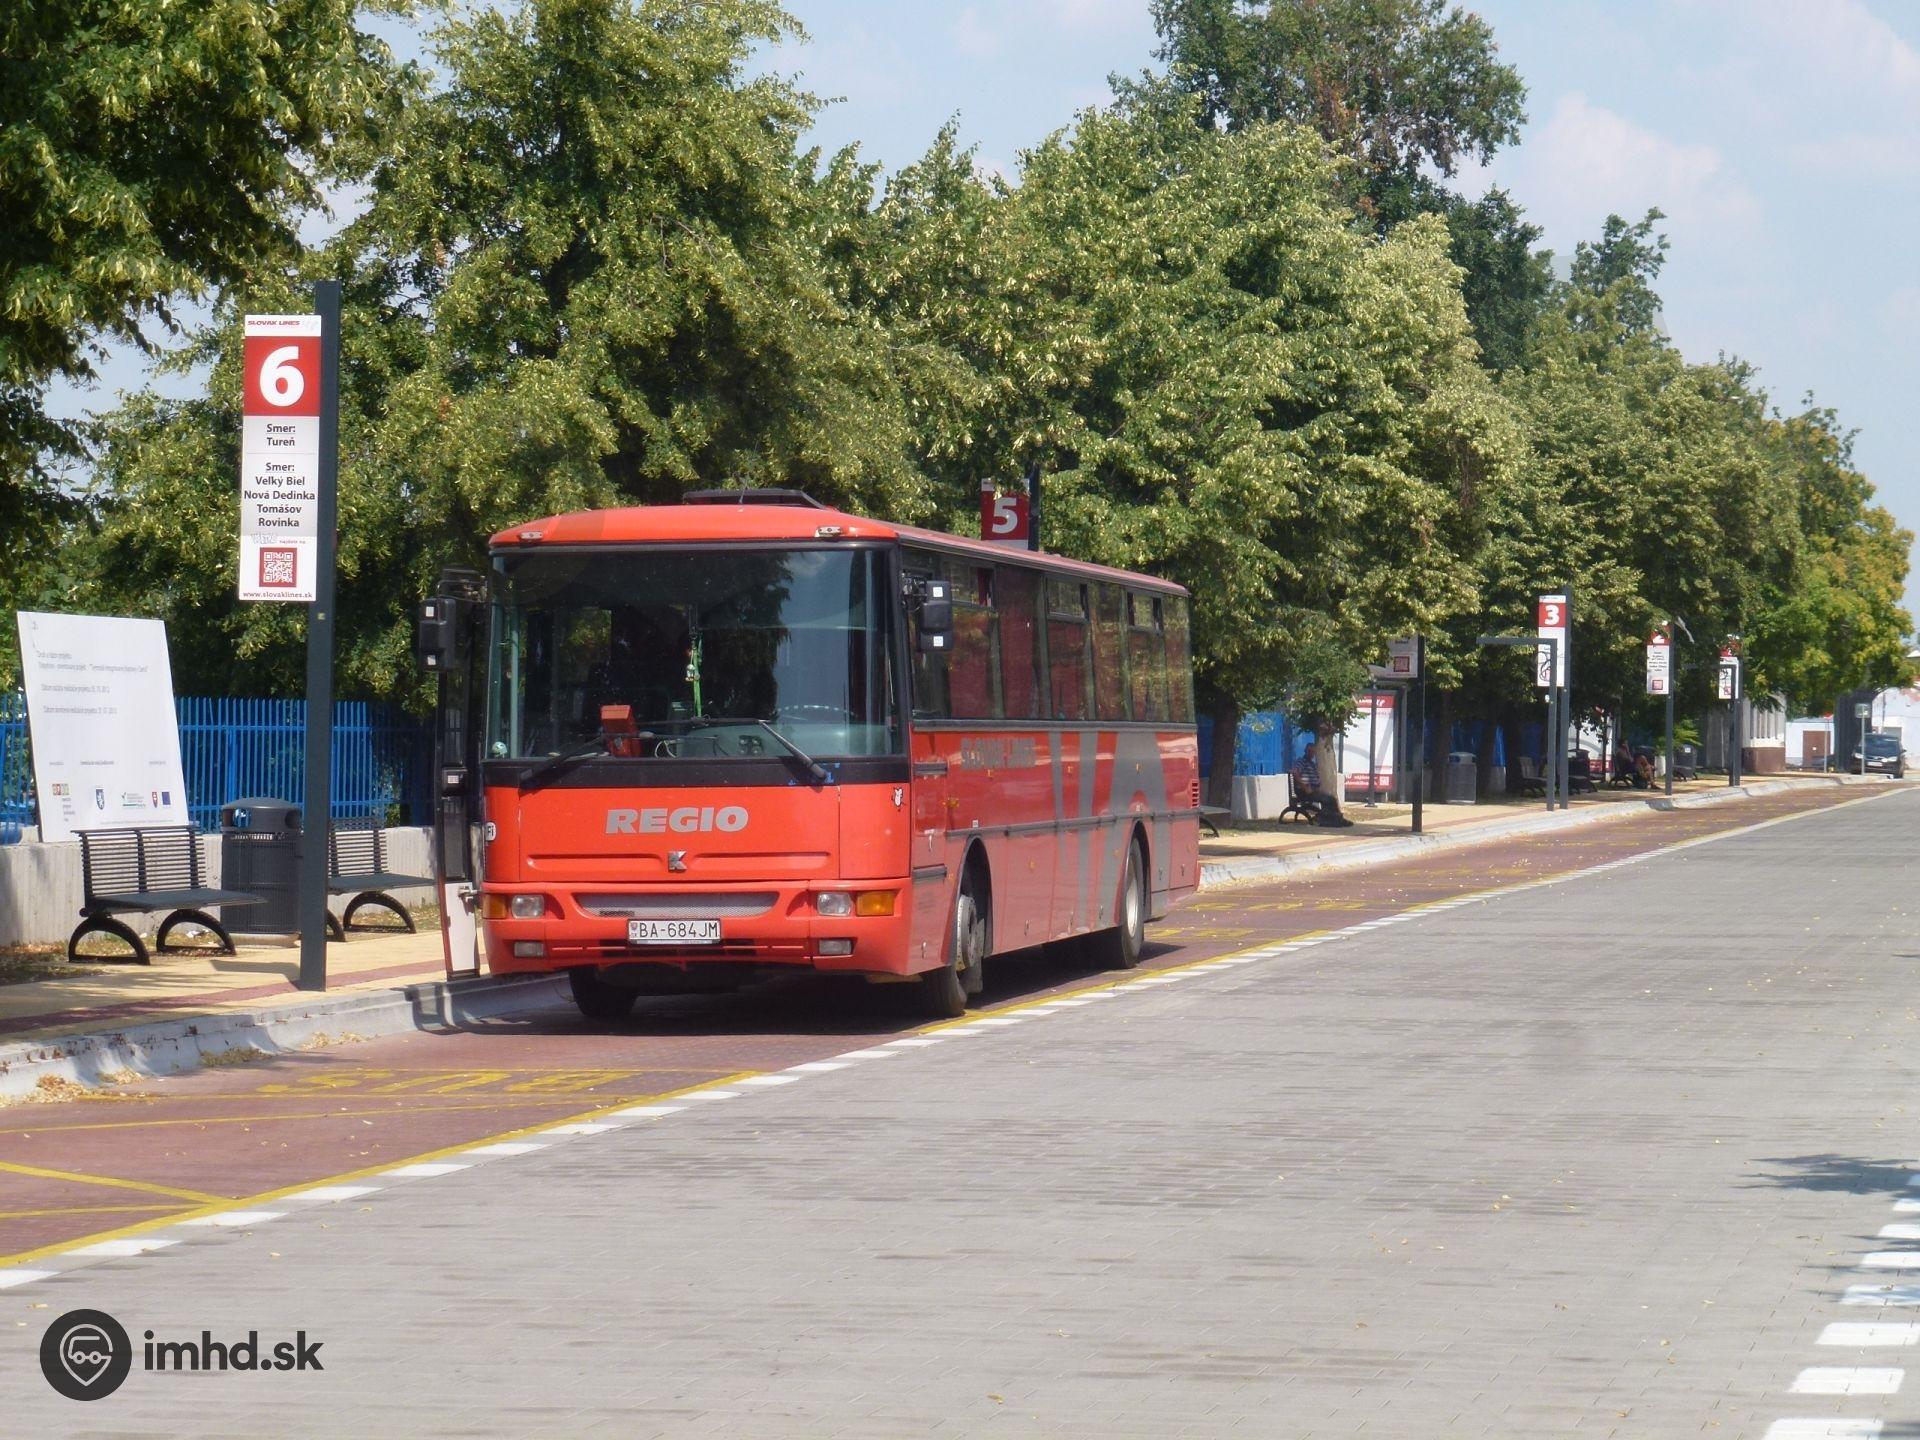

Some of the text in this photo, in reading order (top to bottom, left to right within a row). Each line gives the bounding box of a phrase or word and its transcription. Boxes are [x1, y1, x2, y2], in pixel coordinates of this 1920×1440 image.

[260, 345, 304, 407] 6
[266, 423, 296, 433] Smer:
[265, 462, 295, 472] Smer:
[286, 476, 305, 486] Biel
[244, 490, 316, 500] Nová Dedinka
[257, 503, 302, 514] Tomášov
[991, 497, 1018, 534] 5
[258, 517, 300, 527] Rovinka
[243, 591, 313, 599] www.slovaklines.sk
[1544, 604, 1560, 625] 3
[605, 805, 749, 834] REGIO
[667, 850, 688, 872] K
[639, 922, 718, 938] BA-684JM
